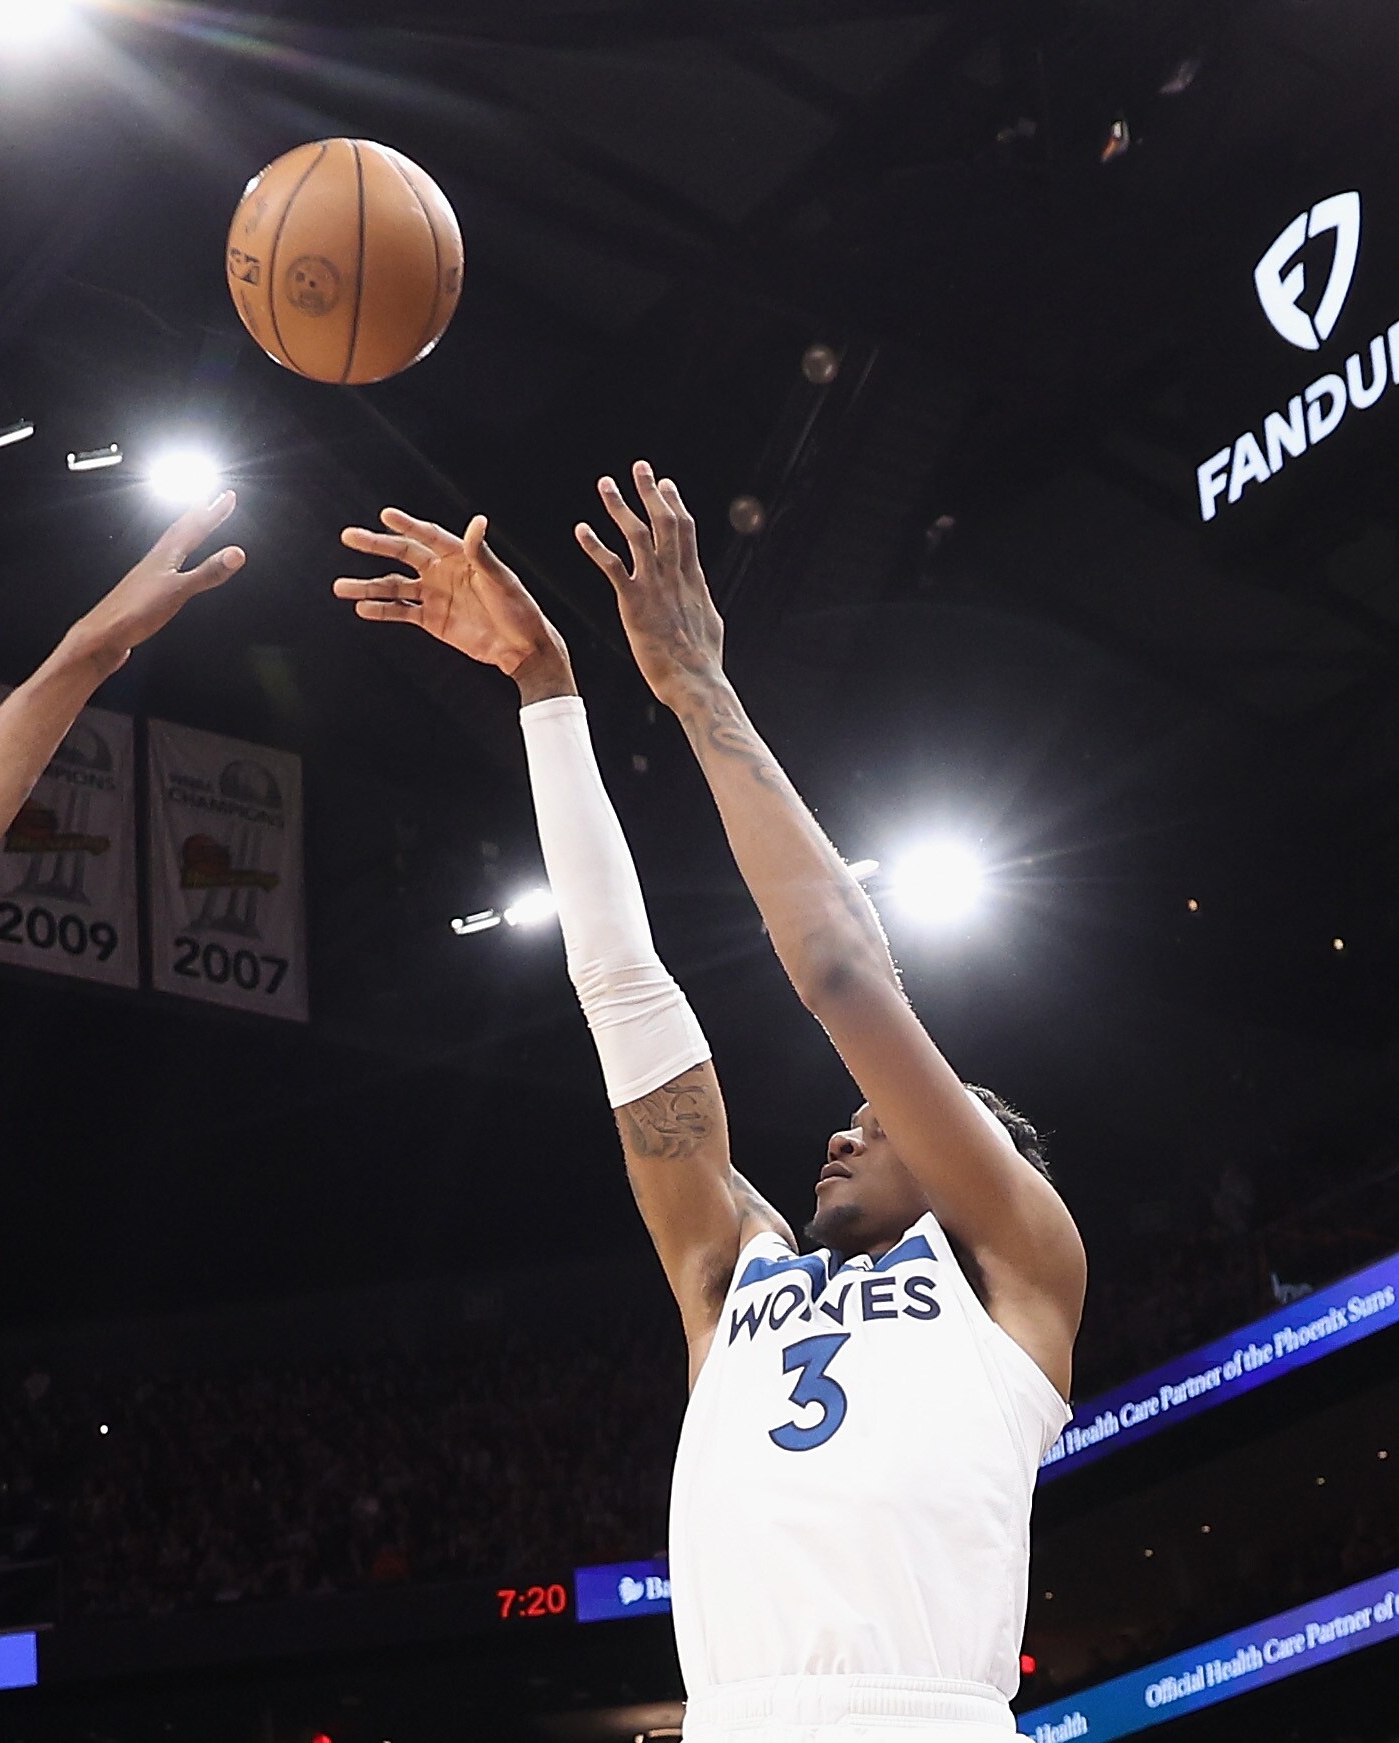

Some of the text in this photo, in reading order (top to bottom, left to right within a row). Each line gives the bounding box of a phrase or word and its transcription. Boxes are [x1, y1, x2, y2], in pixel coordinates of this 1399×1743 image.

[173, 936, 289, 995] 2007
[768, 1332, 851, 1452] 3
[1065, 1411, 1119, 1455] Health
[1120, 1395, 1160, 1428] Care
[1160, 1365, 1222, 1412] Partner
[1222, 1348, 1243, 1381] of
[1242, 1341, 1274, 1372] the
[1273, 1306, 1348, 1359] Phoenix
[1347, 1284, 1396, 1323] Suns
[497, 1584, 568, 1618] 7:20
[1144, 1664, 1205, 1708] Official
[1205, 1643, 1263, 1688] Health
[1262, 1632, 1305, 1665] Care
[1305, 1605, 1373, 1649] Partner
[1373, 1590, 1395, 1623] of
